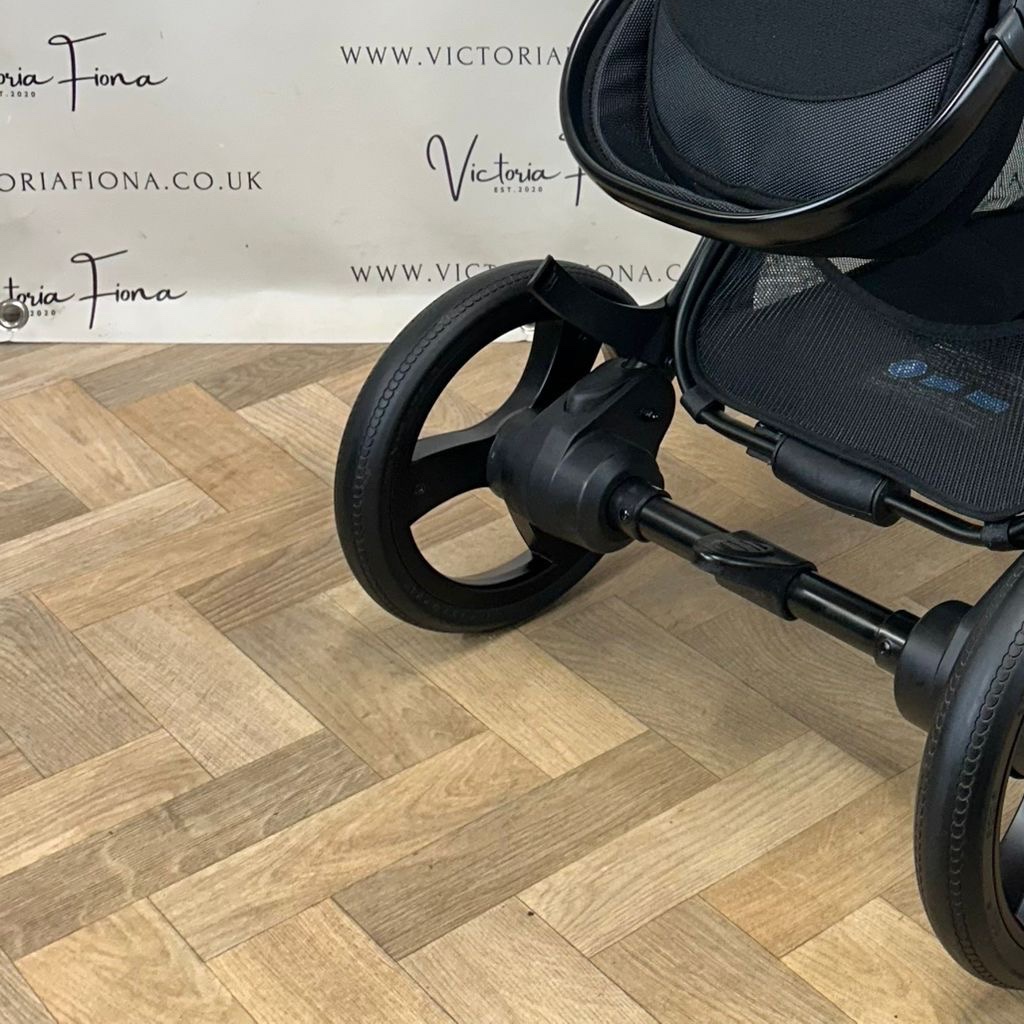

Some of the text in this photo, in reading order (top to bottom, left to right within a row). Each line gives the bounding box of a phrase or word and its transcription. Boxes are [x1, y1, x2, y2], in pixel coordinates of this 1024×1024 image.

[0, 32, 168, 112] oria Fiona
[0, 171, 263, 192] ORIAFIONA.CO.UK
[426, 134, 561, 202] Victoria
[3, 249, 187, 330] toria Fiona
